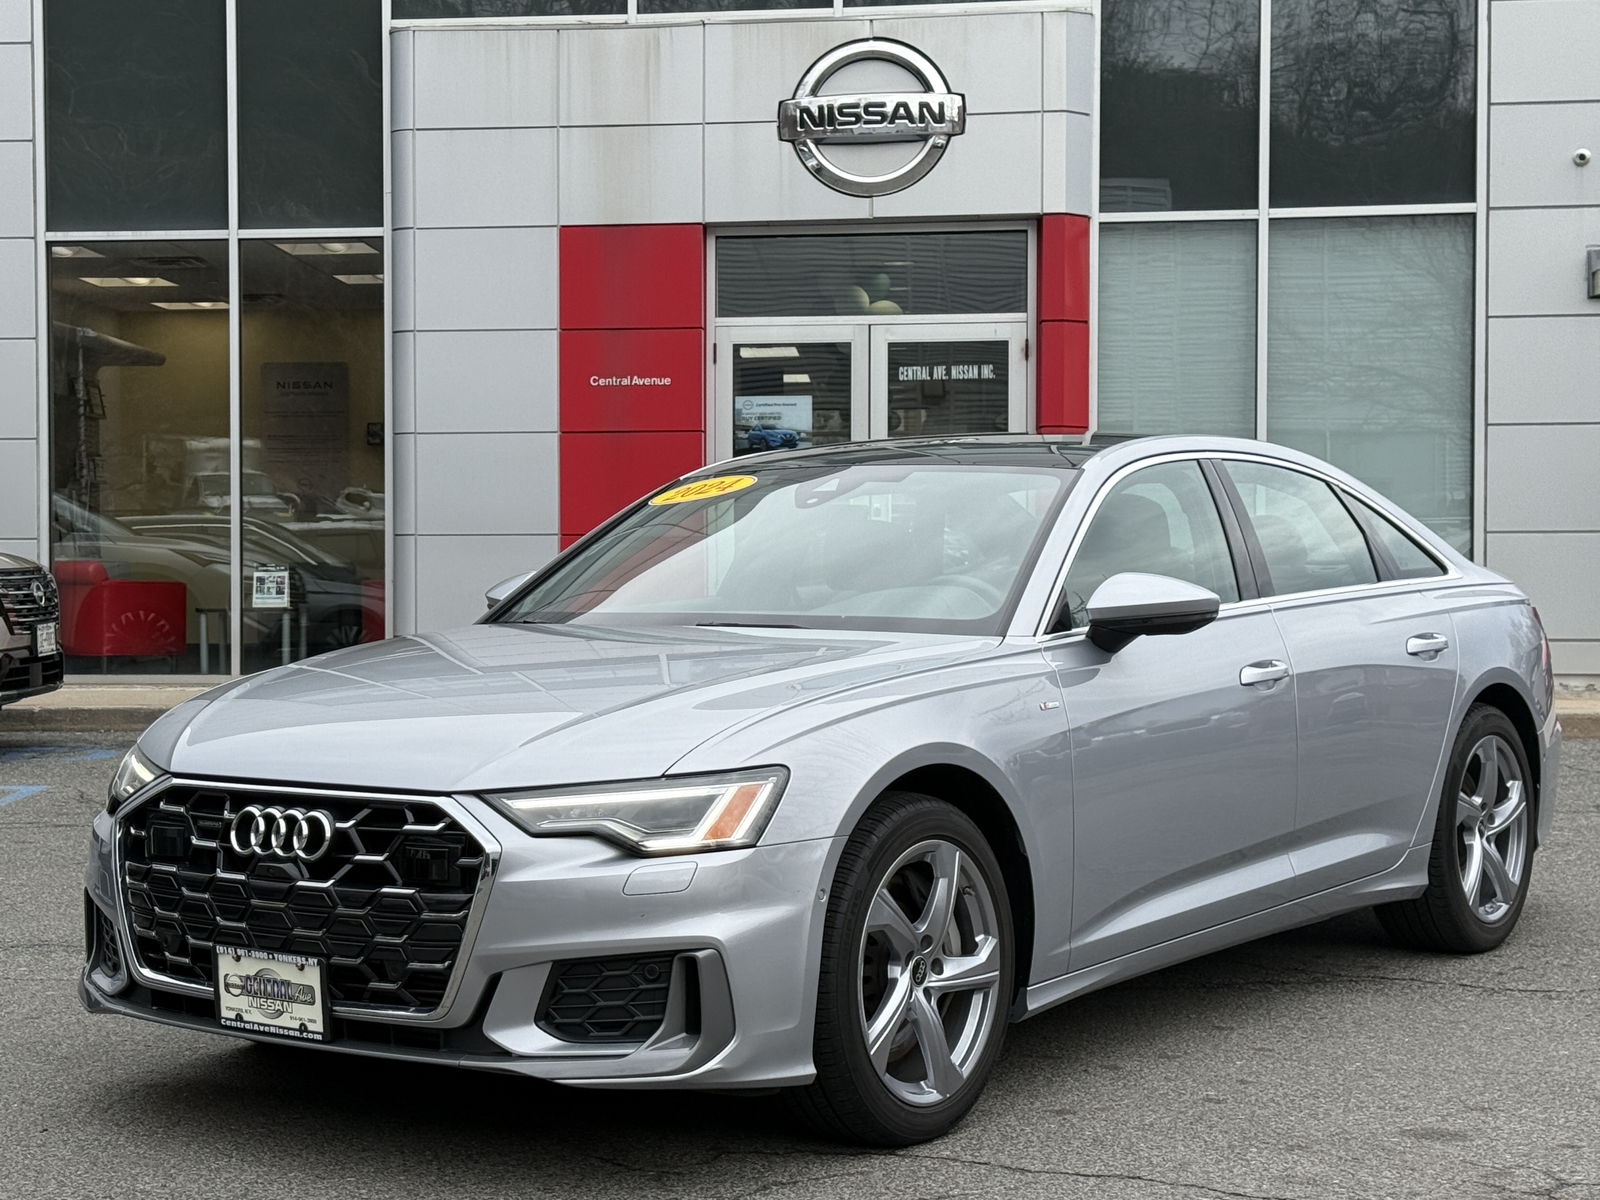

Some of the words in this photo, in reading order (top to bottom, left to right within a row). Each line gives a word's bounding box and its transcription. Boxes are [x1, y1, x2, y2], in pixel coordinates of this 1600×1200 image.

[797, 101, 946, 131] NISSAN
[589, 375, 631, 386] Central
[631, 375, 672, 386] Avenue
[898, 366, 931, 381] CENTRAL
[933, 366, 949, 380] AVE.
[951, 364, 979, 380] NISSAN
[981, 364, 996, 380] INC.
[277, 381, 333, 389] NISSAN
[662, 478, 744, 502] 2024
[245, 974, 293, 1000] CENTRAL
[248, 997, 293, 1014] NISSAN
